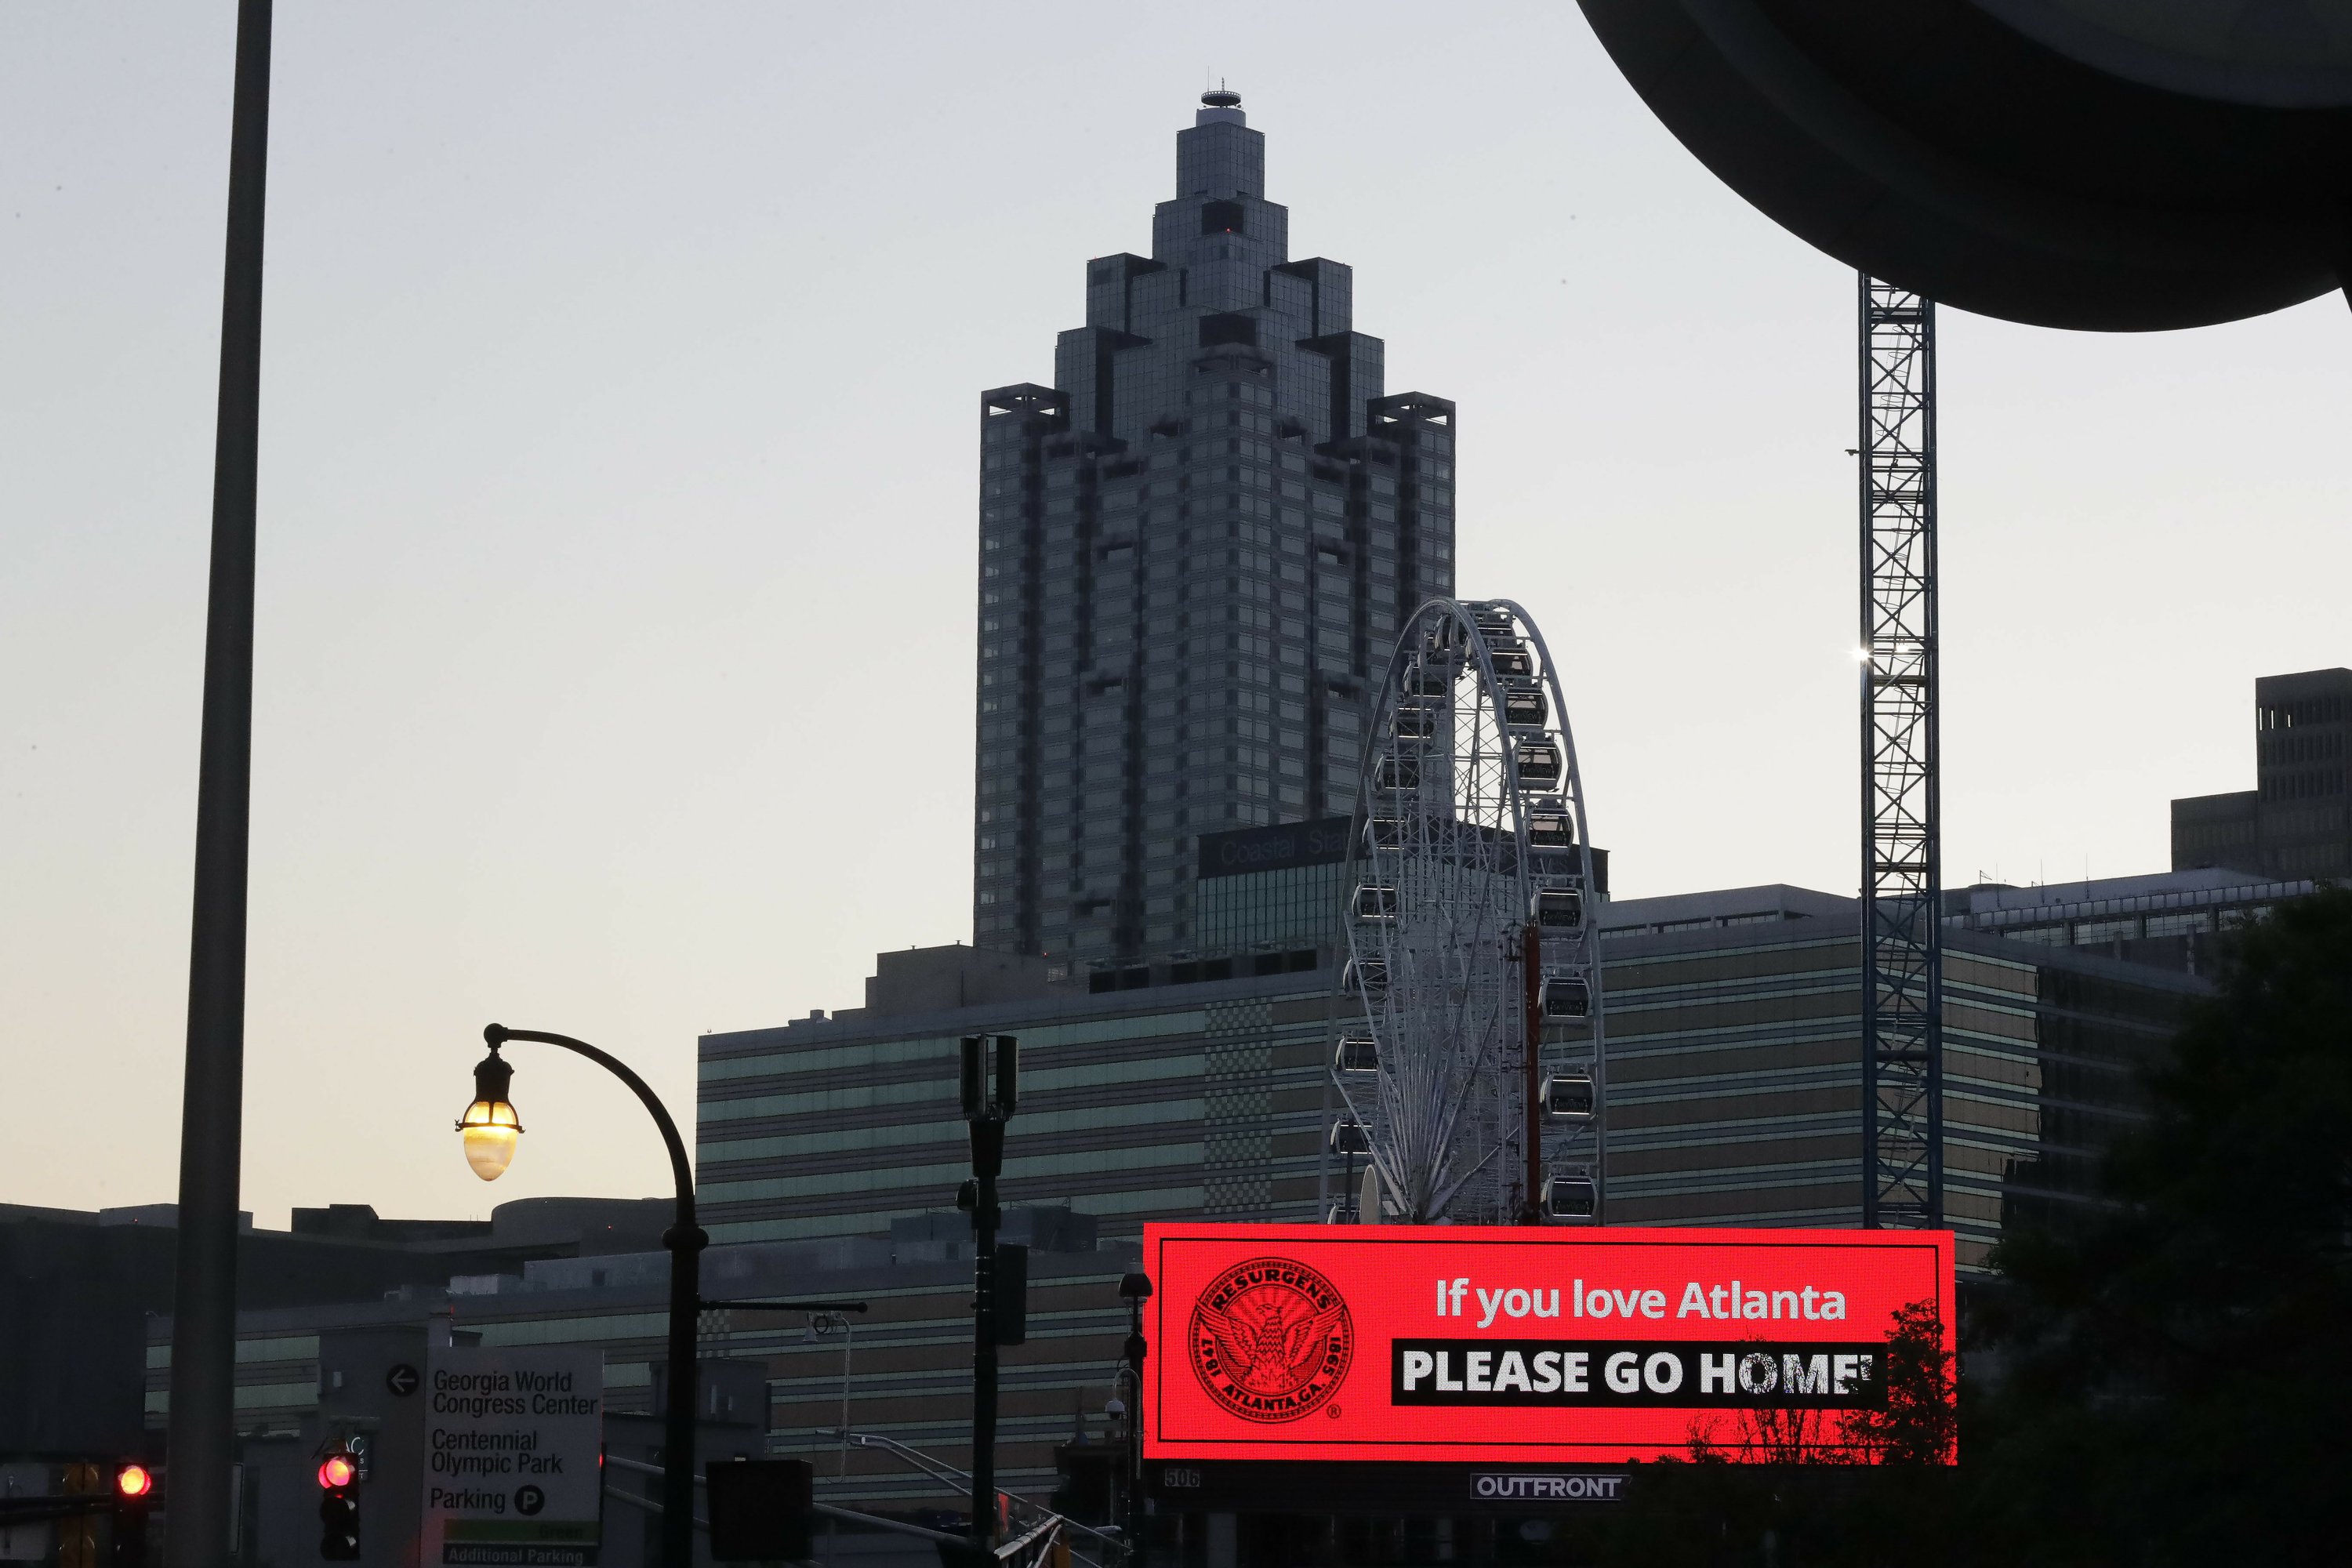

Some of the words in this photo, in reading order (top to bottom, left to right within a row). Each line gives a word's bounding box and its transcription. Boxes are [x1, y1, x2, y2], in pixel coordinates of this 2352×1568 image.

[1221, 834, 1295, 866] Coastal
[1211, 1269, 1331, 1311] RESURGENS
[1437, 1278, 1470, 1318] If
[1475, 1287, 1559, 1329] you
[1574, 1279, 1666, 1319] love
[1676, 1281, 1846, 1321] Atlanta
[1202, 1338, 1222, 1377] 1847
[1323, 1337, 1341, 1377] 1865
[434, 1369, 510, 1396] Georgia
[515, 1370, 572, 1393] World
[1403, 1351, 1589, 1393] PLEASE
[1604, 1352, 1683, 1394] GO
[433, 1392, 526, 1418] Congress
[532, 1393, 598, 1415] Center
[431, 1428, 537, 1450] Centennial
[430, 1451, 511, 1477] Olympic
[517, 1453, 564, 1474] Park
[1165, 1468, 1200, 1487] 506
[1476, 1476, 1622, 1497] OUTFRONT
[430, 1488, 506, 1514] Parking
[539, 1523, 584, 1539] Green
[448, 1547, 525, 1563] Additional
[528, 1548, 584, 1566] Parking
